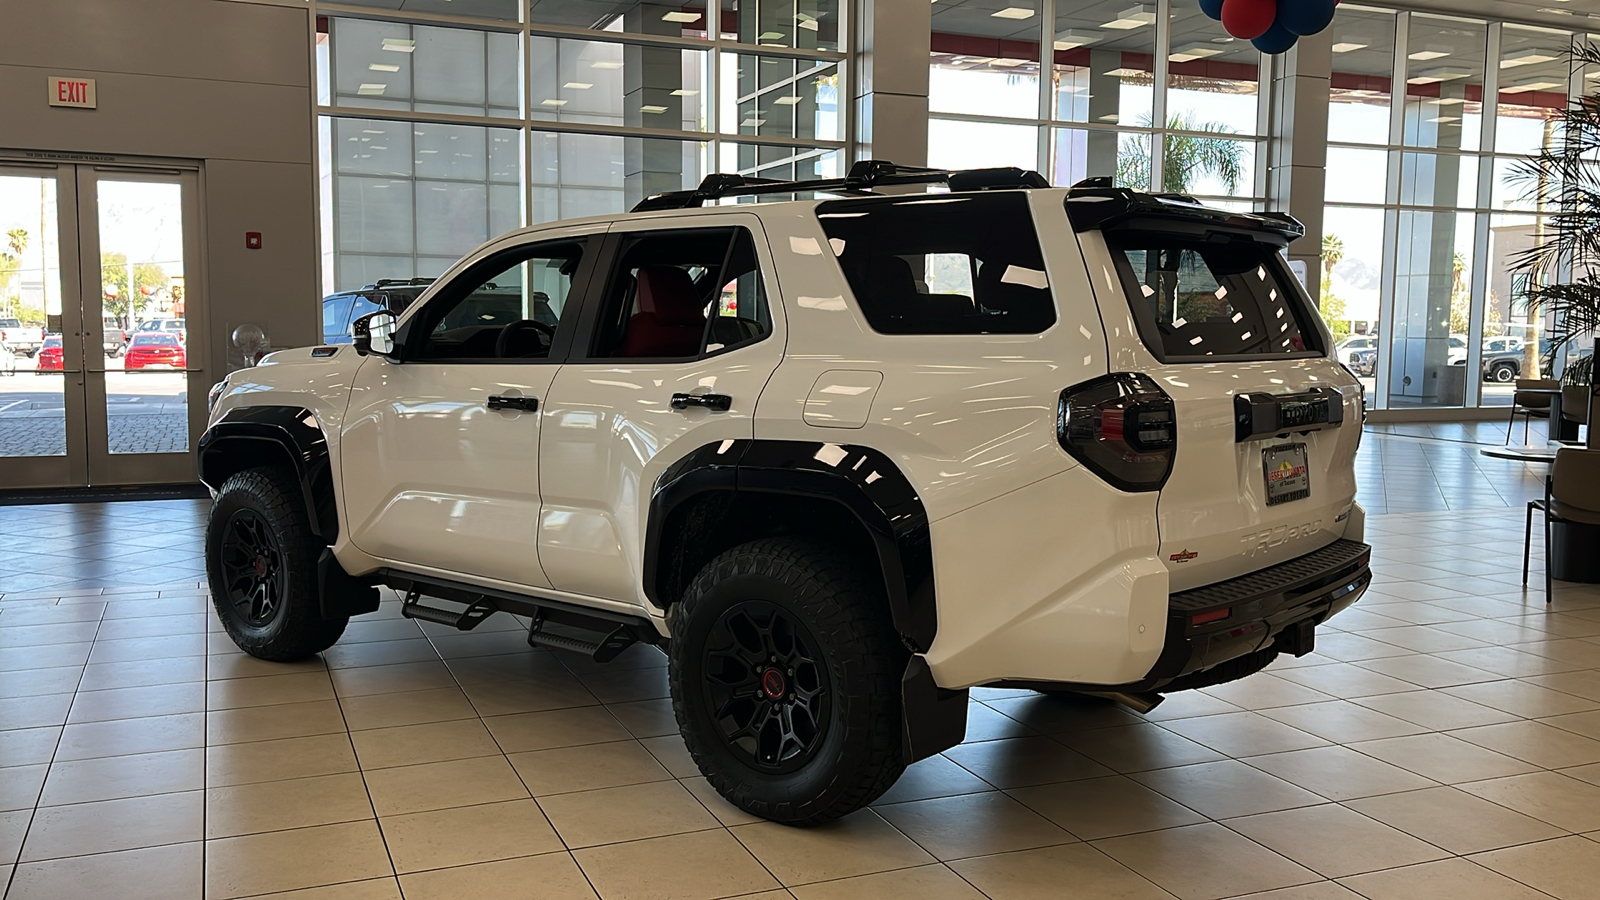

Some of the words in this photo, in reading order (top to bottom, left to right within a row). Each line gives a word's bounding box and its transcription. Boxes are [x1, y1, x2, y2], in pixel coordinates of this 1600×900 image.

[58, 81, 88, 103] EXIT
[1288, 403, 1327, 424] TOYOTA
[1270, 493, 1289, 505] DESERT
